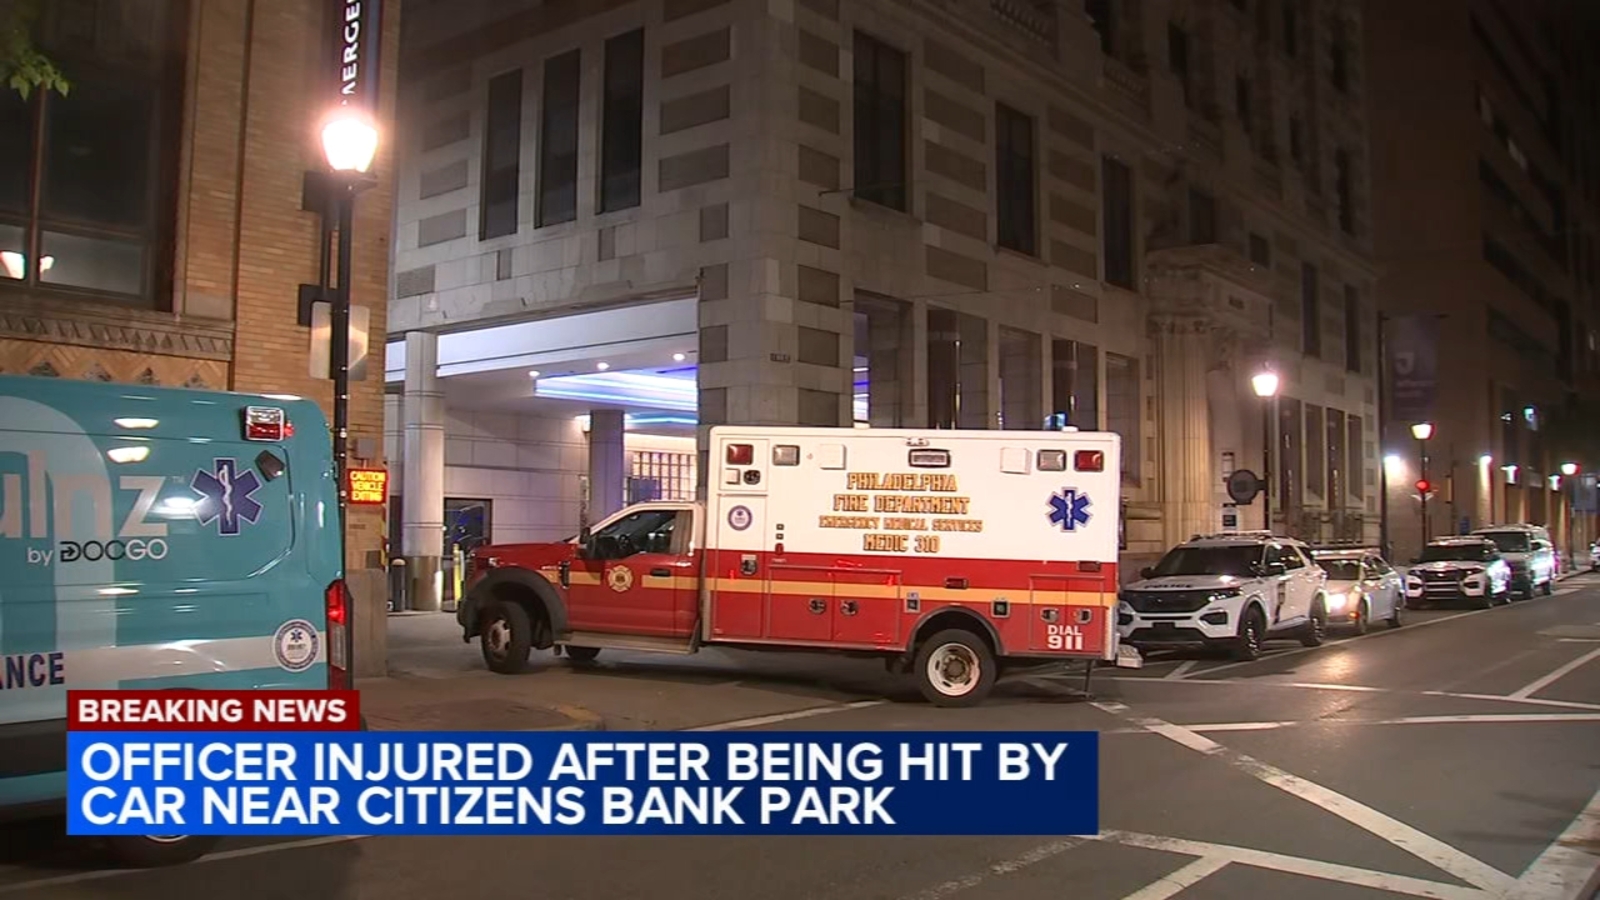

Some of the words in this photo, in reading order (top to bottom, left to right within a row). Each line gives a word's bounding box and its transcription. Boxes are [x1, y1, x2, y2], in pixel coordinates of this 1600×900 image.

[341, 0, 361, 106] MERGE
[846, 472, 958, 492] PHILADELPHIA
[833, 493, 868, 512] FIRE
[874, 495, 971, 514] DEPARTMENT
[818, 515, 880, 530] EMERGENCY
[883, 517, 928, 531] MEDICAL
[931, 518, 983, 532] SERVICES
[27, 546, 53, 567] by
[60, 537, 169, 563] DOCGO
[863, 533, 909, 552] MEDIC
[914, 535, 941, 554] 310
[1047, 624, 1083, 636] DIAL
[1047, 635, 1083, 650] 911
[0, 652, 65, 690] NCE
